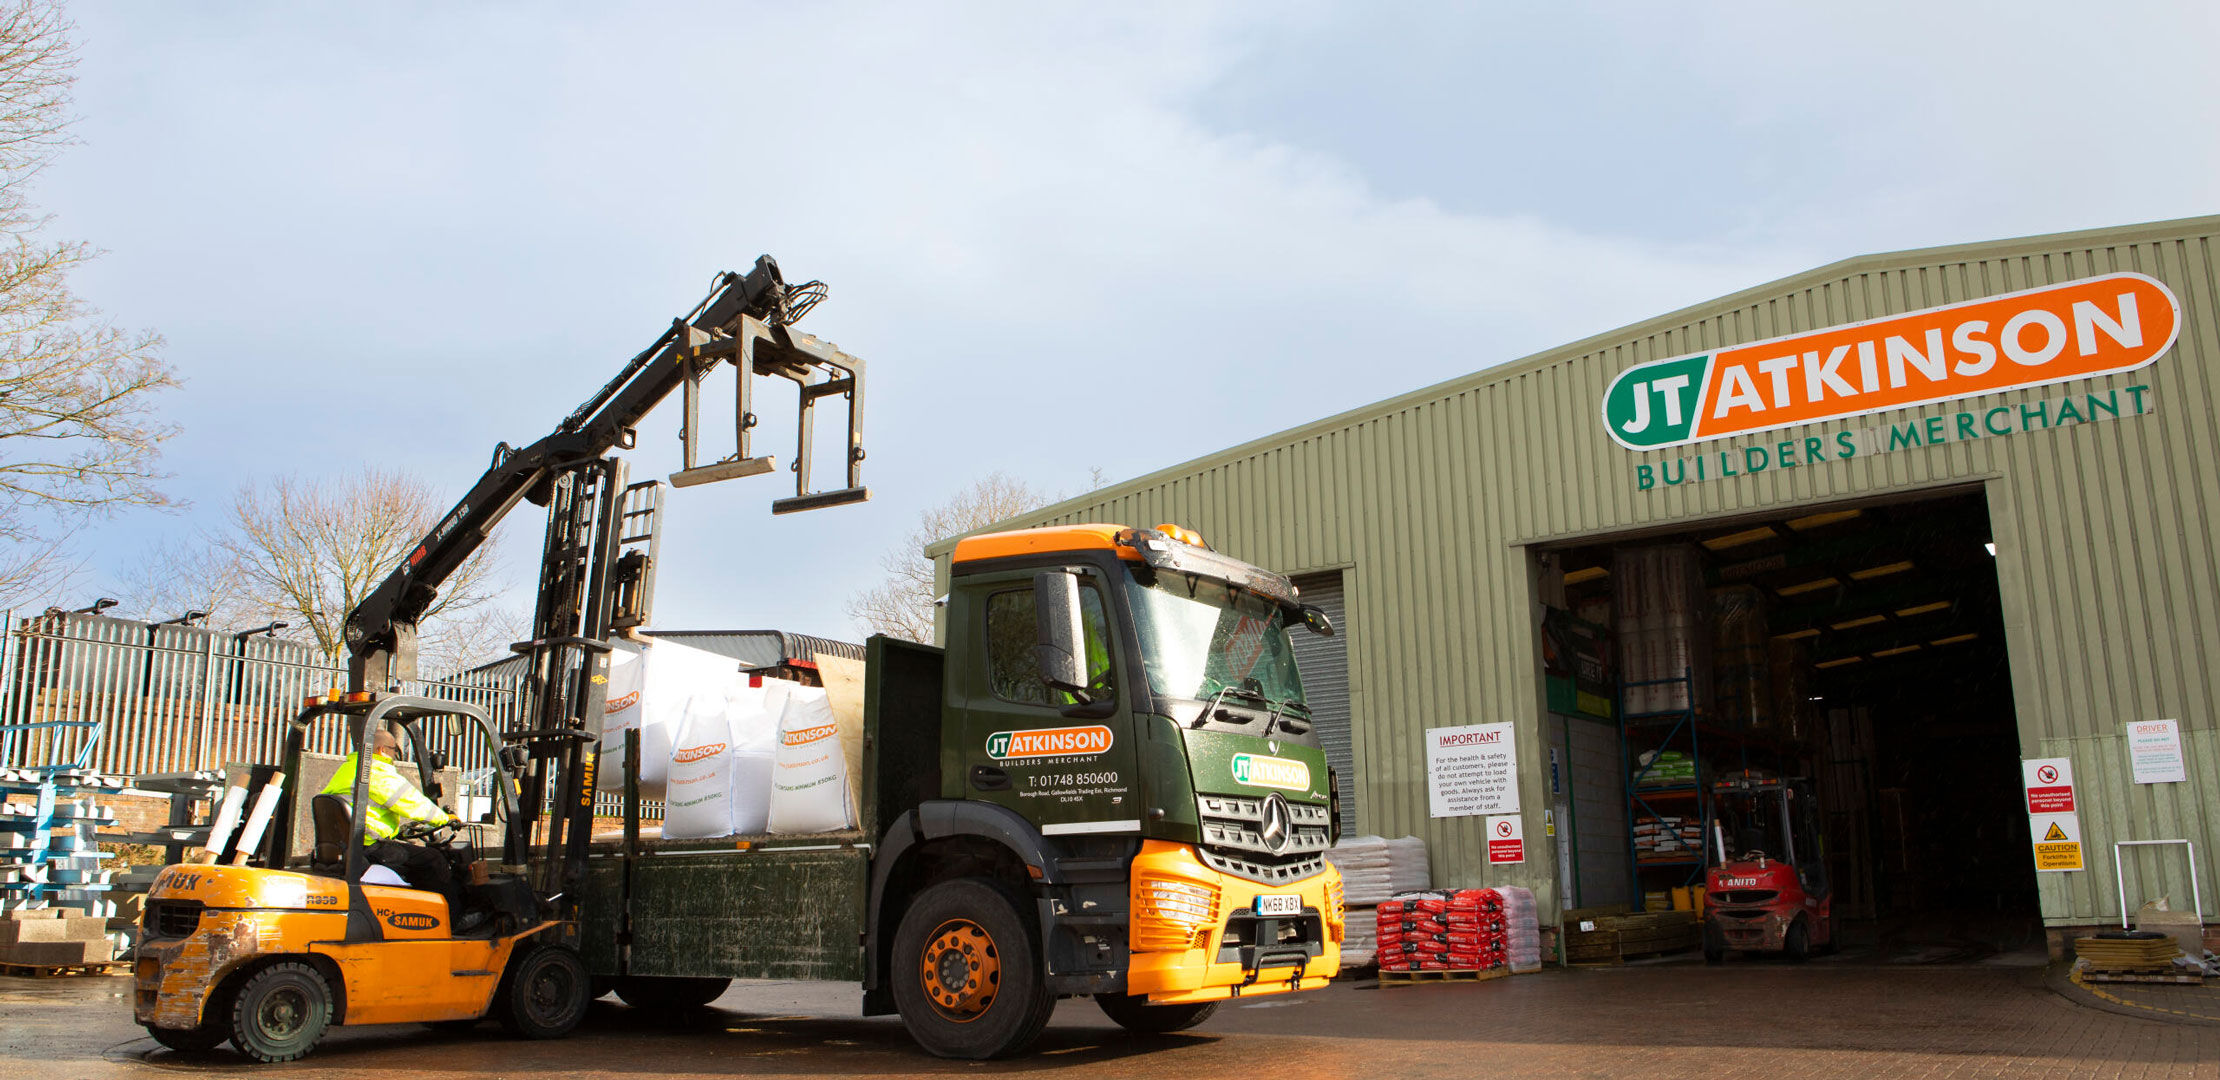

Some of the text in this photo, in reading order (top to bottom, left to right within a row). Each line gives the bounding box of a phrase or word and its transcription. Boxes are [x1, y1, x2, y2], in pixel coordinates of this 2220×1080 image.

[1621, 292, 2144, 434] JT ATKINSON
[1637, 385, 2150, 491] BUILDERS MERCHANT
[2137, 724, 2168, 733] DRIVER
[990, 732, 1105, 754] JT ATKINSON
[1440, 731, 1501, 745] IMPORTANT
[1000, 756, 1098, 767] BUILDERS MERCHANT
[1460, 754, 1479, 762] health
[1236, 760, 1306, 784] JT ATKINSON
[1452, 763, 1486, 771] customers,
[581, 751, 596, 806] SAMUK
[1028, 771, 1118, 787] T: 01748 850600
[1263, 896, 1299, 911] NK68 XBX
[394, 915, 433, 927] SAMUK
